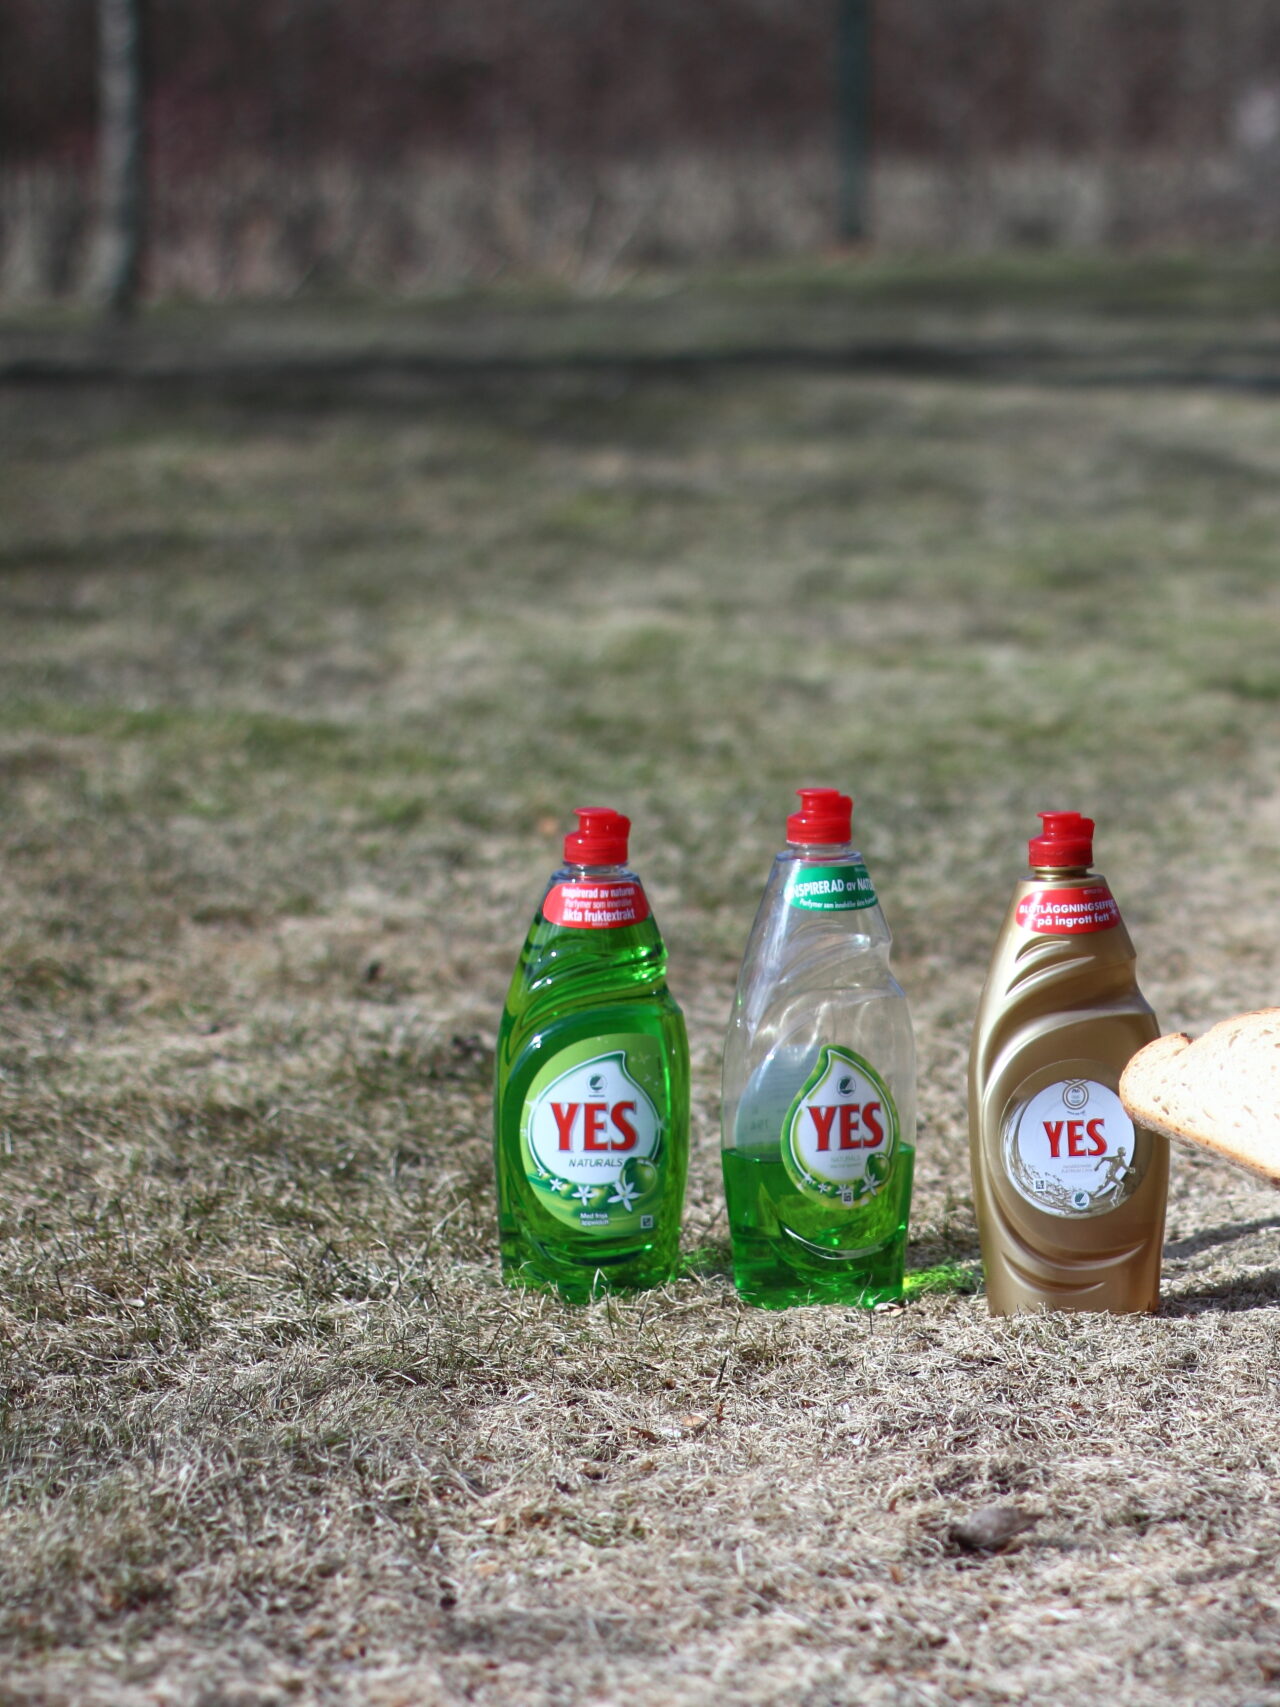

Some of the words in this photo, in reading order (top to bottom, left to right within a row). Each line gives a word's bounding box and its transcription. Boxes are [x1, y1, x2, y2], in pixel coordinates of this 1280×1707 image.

[600, 889, 608, 898] av
[793, 879, 844, 897] NSPIRERAD
[847, 881, 856, 891] av
[584, 909, 635, 922] fruktextrakt
[1037, 915, 1052, 927] på
[1055, 915, 1092, 927] ingrott
[550, 1100, 637, 1151] YES
[807, 1102, 884, 1152] YES
[1043, 1118, 1108, 1158] YES
[568, 1157, 623, 1167] NATURALS
